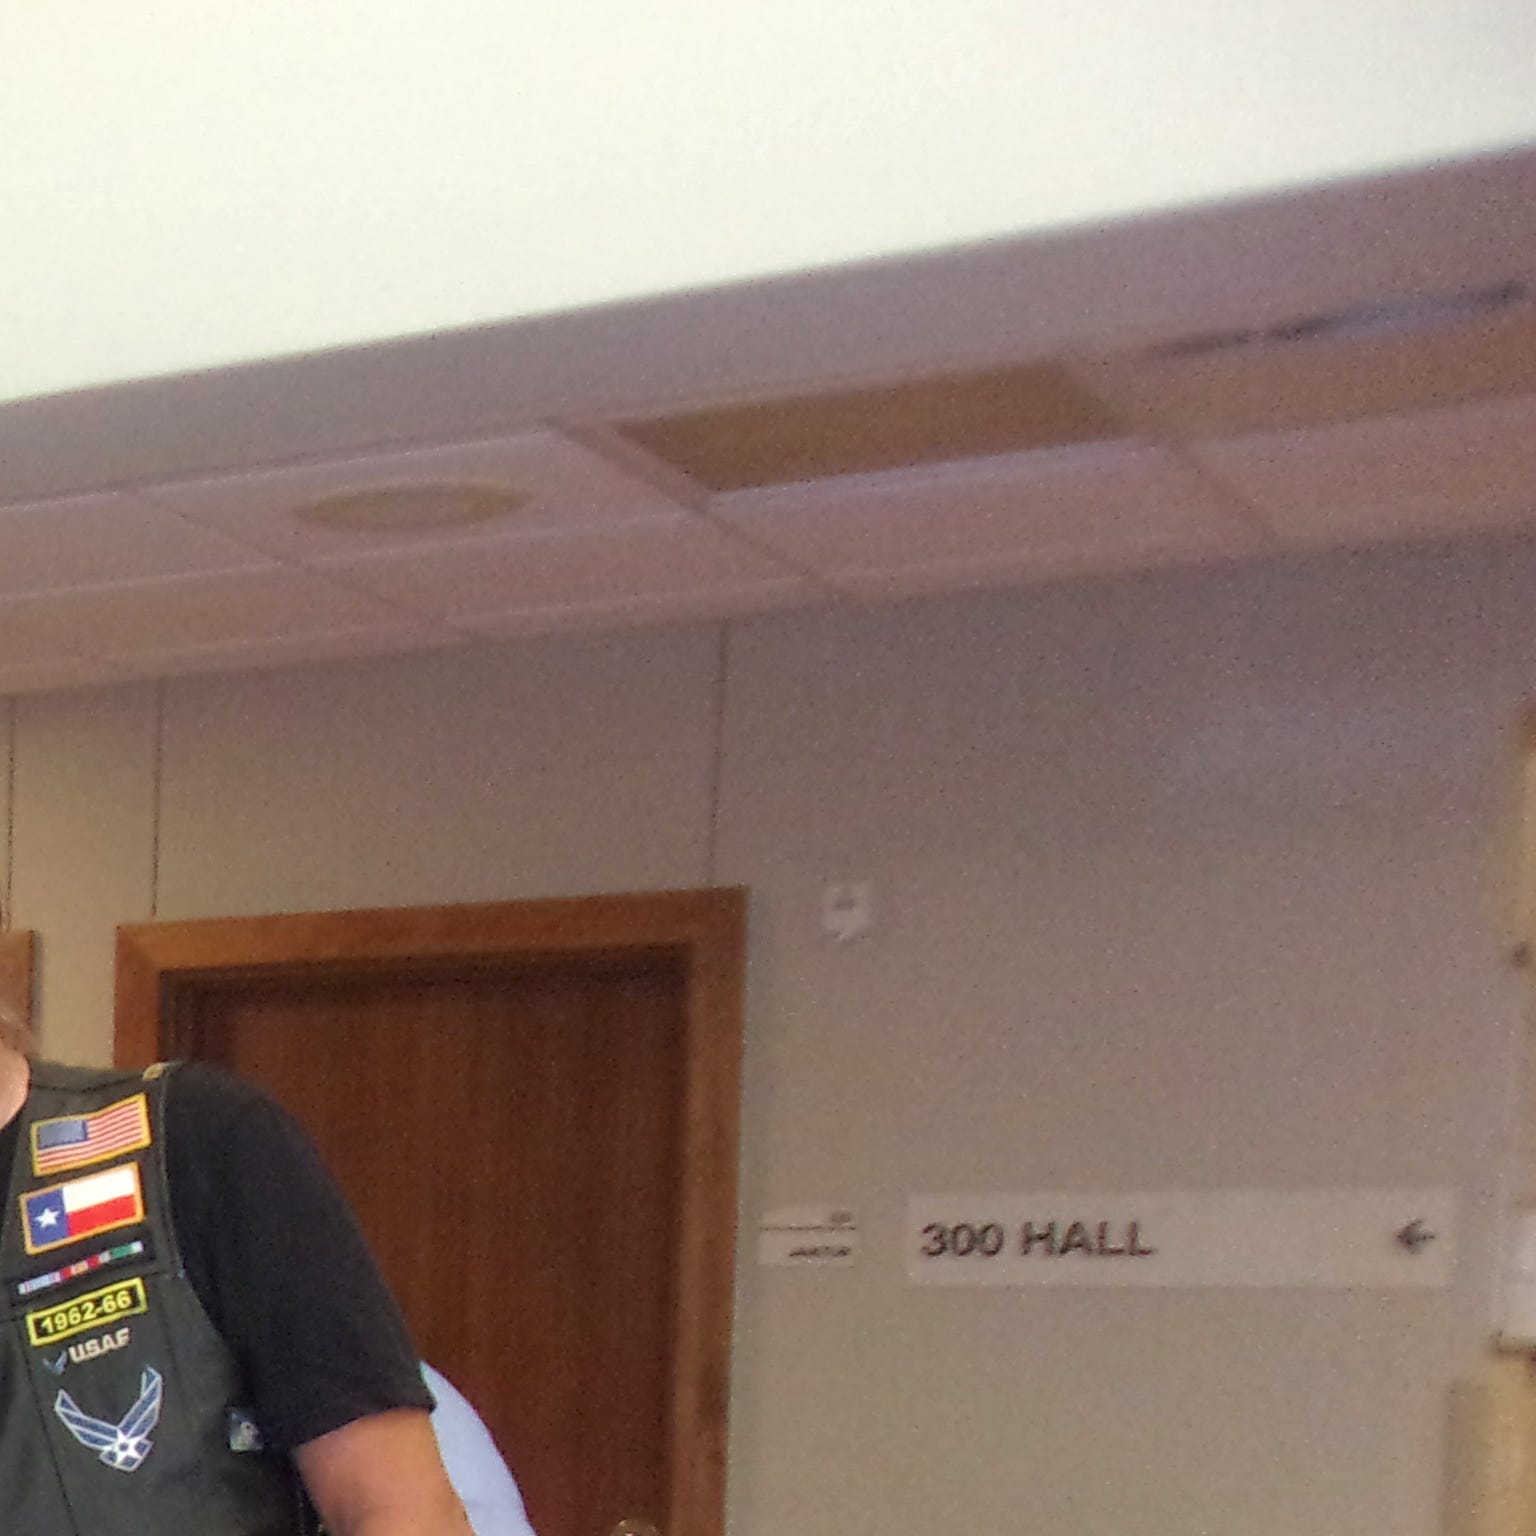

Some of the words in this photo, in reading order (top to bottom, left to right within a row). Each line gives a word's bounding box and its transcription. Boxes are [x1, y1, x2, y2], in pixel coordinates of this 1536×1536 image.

[920, 1222, 1004, 1257] 300
[1020, 1220, 1157, 1257] HALL
[40, 1290, 132, 1333] 1962-66
[68, 1327, 131, 1364] USAF
